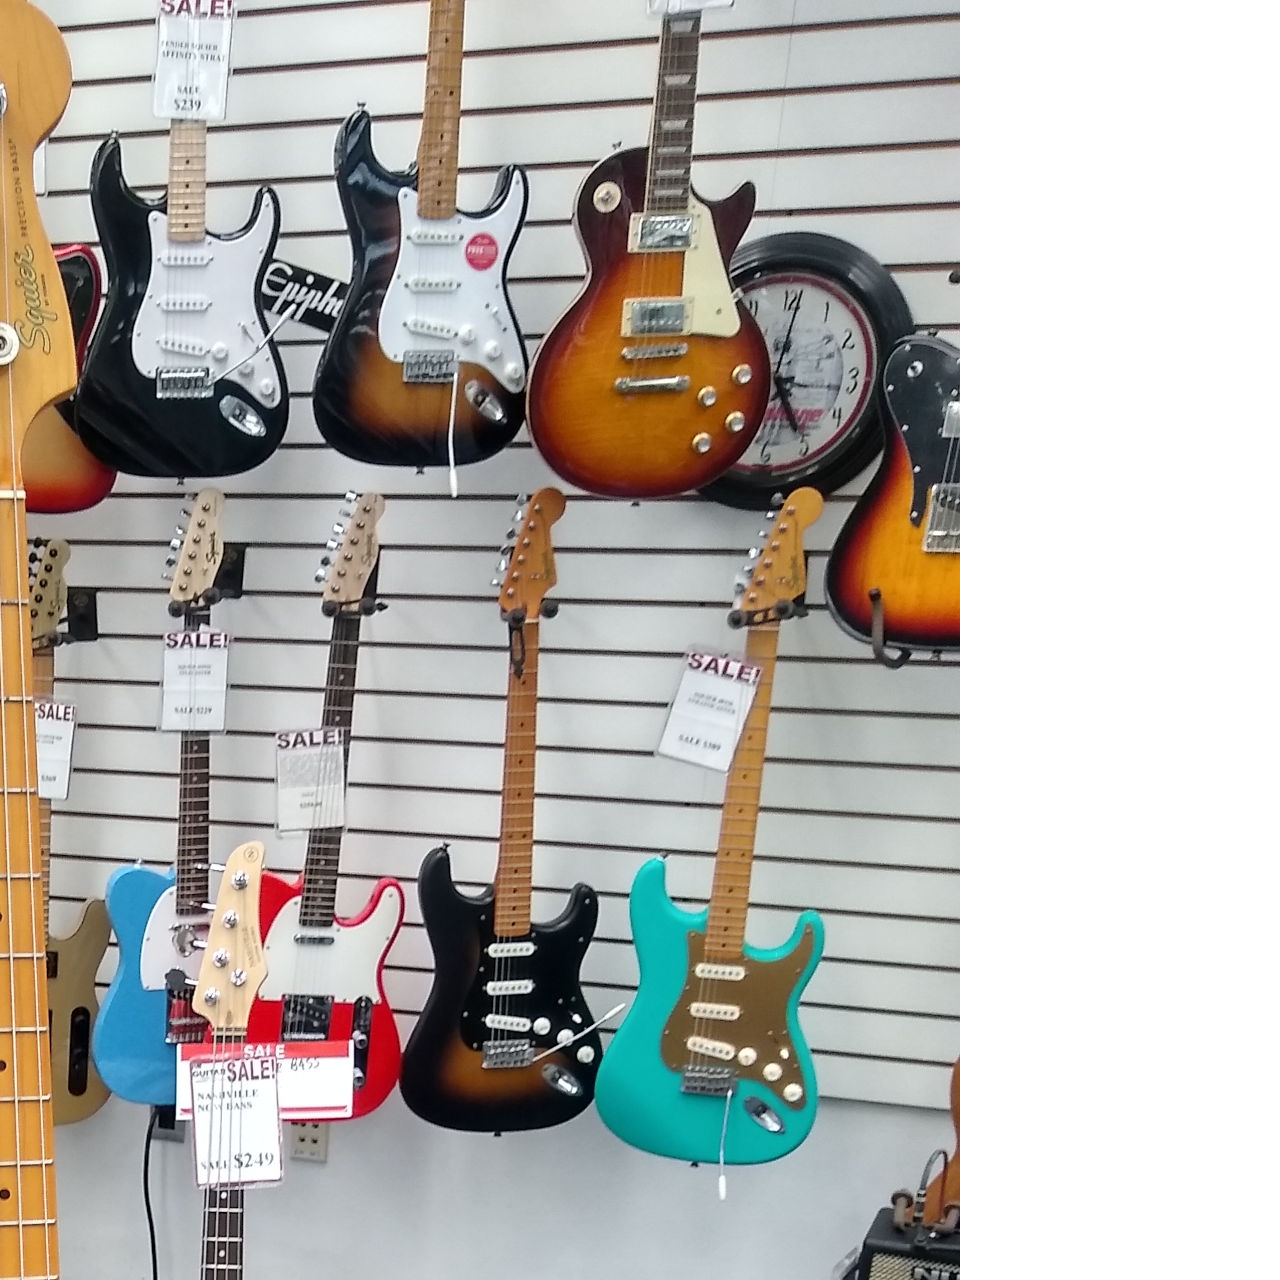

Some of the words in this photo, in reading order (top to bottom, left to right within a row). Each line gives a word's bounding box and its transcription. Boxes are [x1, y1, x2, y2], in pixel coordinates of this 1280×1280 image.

[160, 0, 232, 16] SALE!
[162, 50, 196, 60] AFFINITY
[177, 86, 199, 94] SALE
[174, 99, 201, 111] $239
[15, 177, 29, 237] PRECISION
[13, 243, 57, 354] Squier
[261, 262, 344, 321] Epiph
[784, 289, 803, 312] 12
[823, 301, 830, 323] 1
[842, 328, 856, 350] 2
[846, 366, 860, 394] 3
[832, 407, 842, 428] 4
[760, 440, 771, 464] 6
[799, 433, 810, 457] 5
[166, 633, 227, 648] SALE!
[688, 653, 760, 684] SALE!
[38, 704, 75, 721] SALE!
[277, 730, 342, 749] SALE!
[244, 1044, 285, 1059] SALE
[192, 1068, 226, 1077] GUITAR
[227, 1059, 276, 1082] SALE!
[234, 1153, 275, 1169] $249
